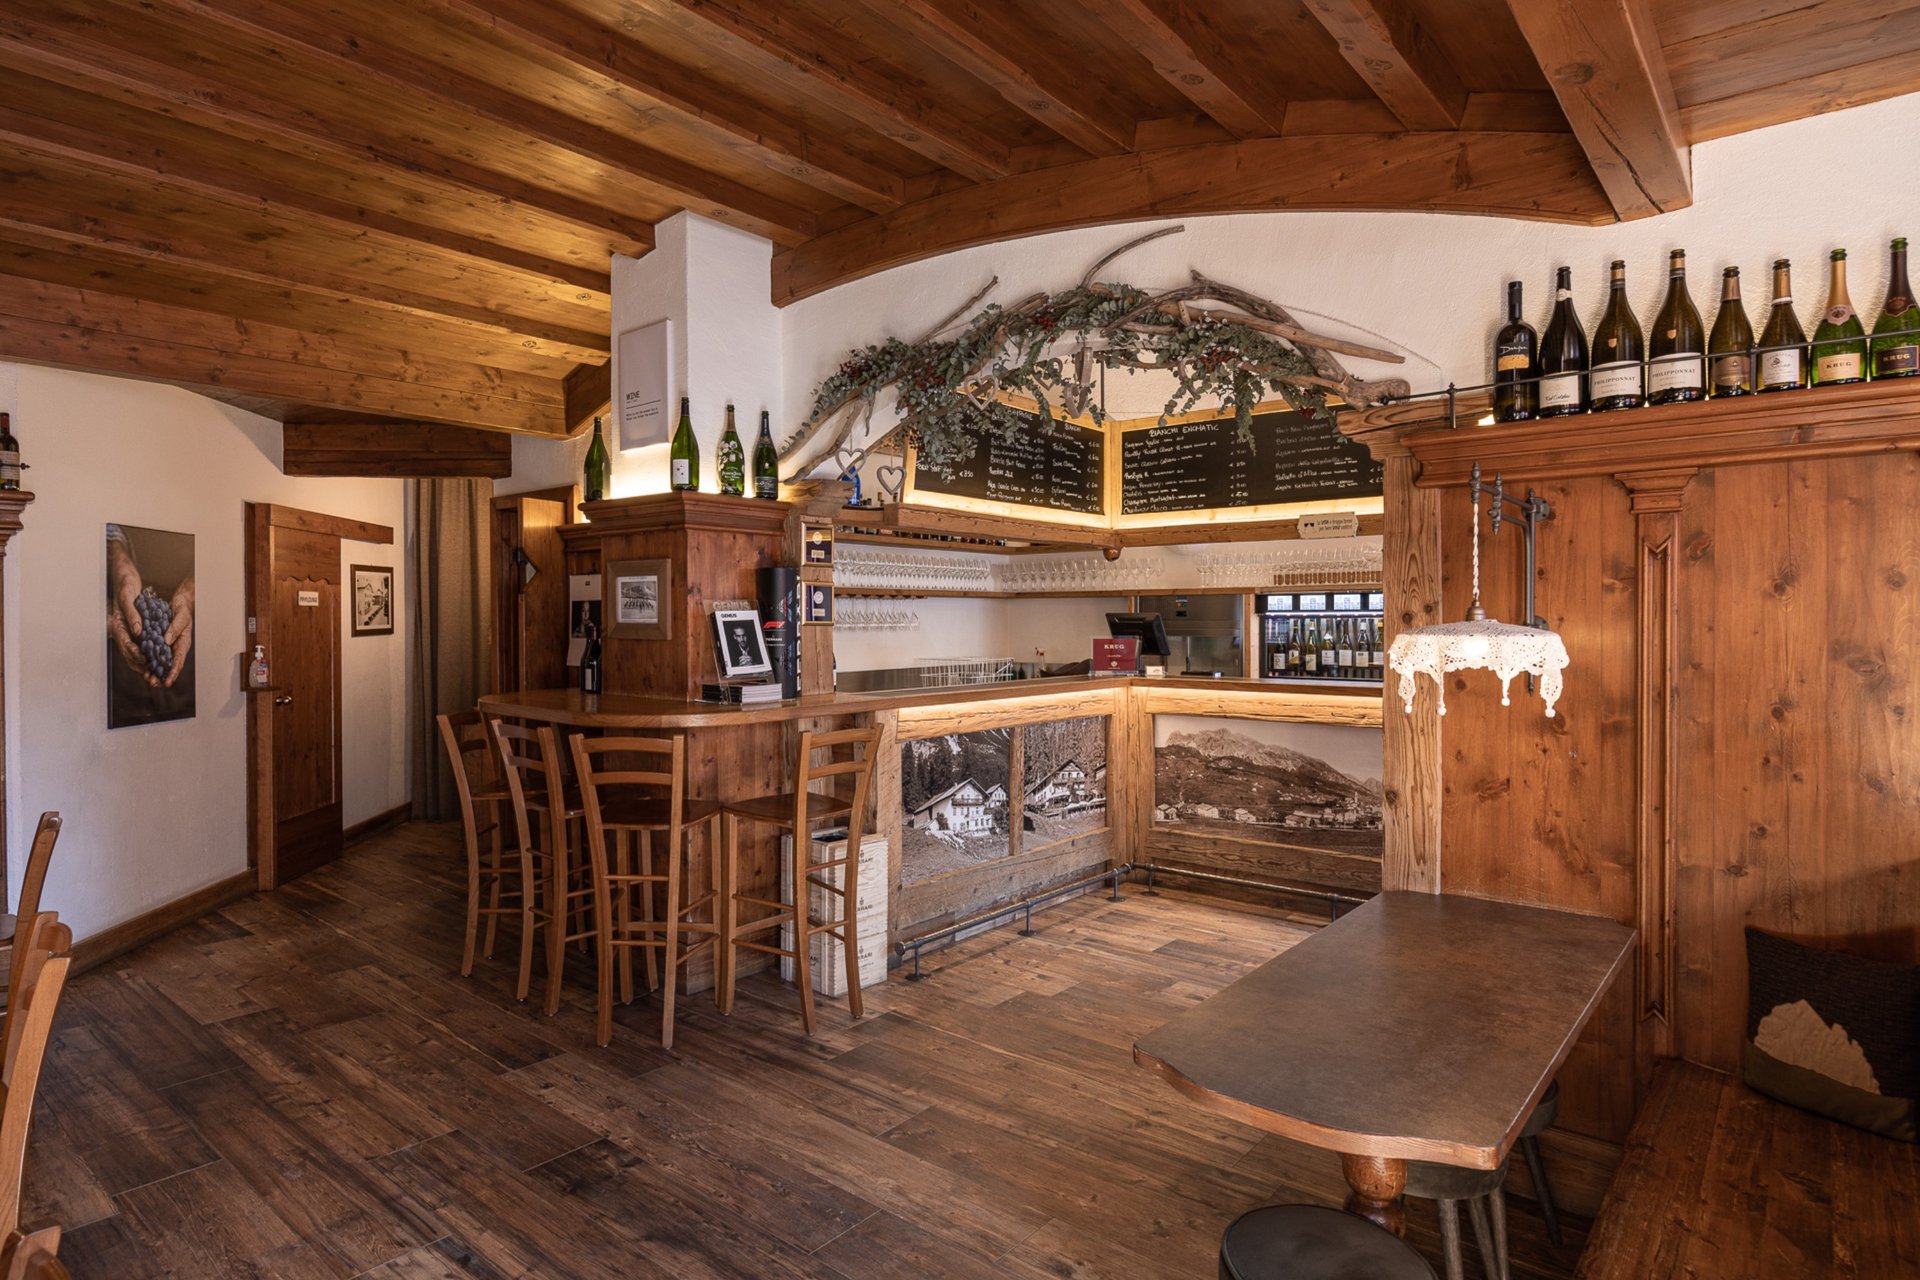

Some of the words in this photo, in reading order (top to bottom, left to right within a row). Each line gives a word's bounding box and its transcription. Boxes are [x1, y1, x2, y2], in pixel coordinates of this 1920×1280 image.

[1882, 353, 1911, 362] KRUG
[1826, 361, 1853, 369] KRUG
[1652, 368, 1696, 378] PHILIPPONNAT
[1594, 376, 1636, 386] PHILIPPONNAT
[1148, 427, 1179, 438] BIANCHI
[713, 601, 751, 610] GENIUS
